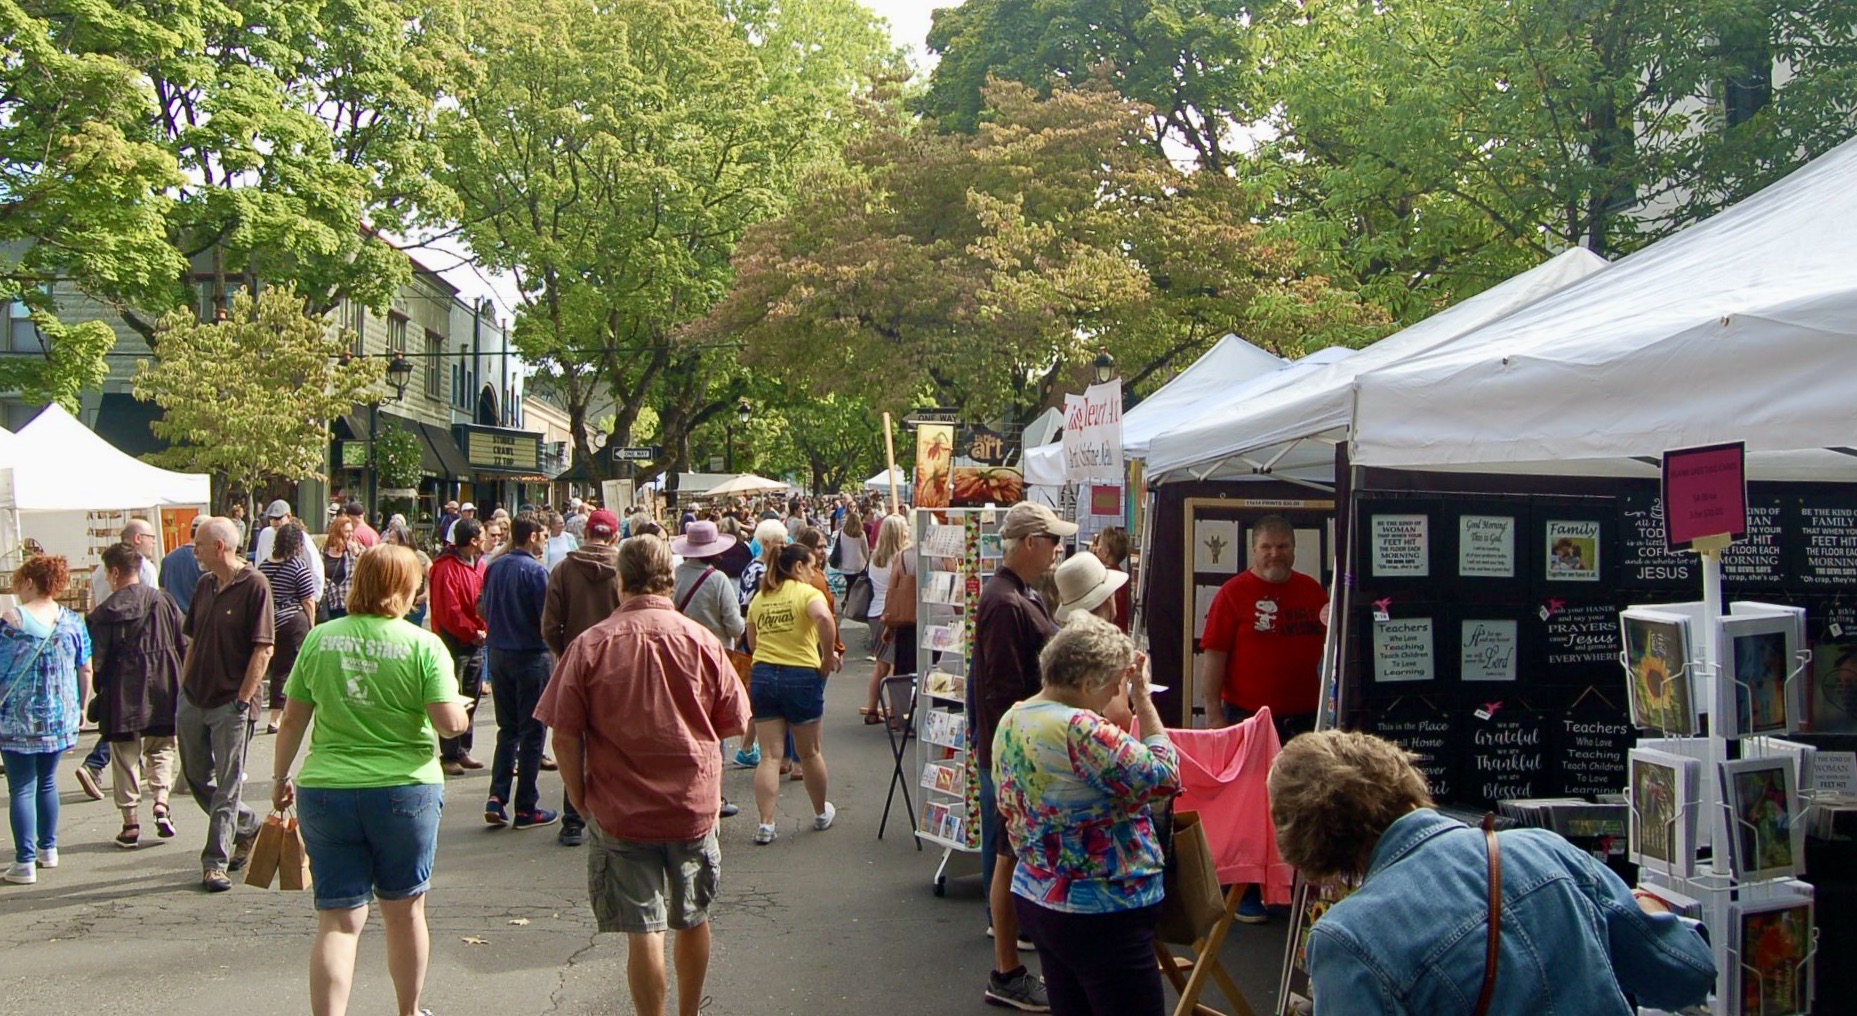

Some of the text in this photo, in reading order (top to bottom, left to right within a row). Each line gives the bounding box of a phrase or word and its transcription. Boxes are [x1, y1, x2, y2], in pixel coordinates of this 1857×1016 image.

[971, 438, 1004, 460] art
[1812, 517, 1854, 526] FAMILY
[1550, 522, 1597, 538] Family
[1638, 528, 1665, 538] TOD
[1753, 535, 1772, 545] HIT
[1812, 536, 1837, 546] FEET
[1821, 548, 1844, 556] FLOOR
[1637, 567, 1688, 579] JESUS
[757, 612, 794, 630] Camas
[1378, 623, 1428, 632] Teachers
[1548, 622, 1617, 633] PRAYERS
[1564, 634, 1617, 647] Jesus
[319, 636, 410, 660] EVENT STAFF
[1549, 652, 1620, 663] EVERYWHERE
[1418, 720, 1449, 732] Place
[1563, 720, 1627, 734] Teachers
[1412, 736, 1444, 748] Home
[1475, 728, 1540, 746] Grateful
[1576, 737, 1612, 747] Who Love
[1567, 749, 1620, 761] Teaching
[1475, 754, 1542, 771] Thankful
[1562, 761, 1624, 771] Teach Children
[1576, 774, 1608, 783] To Love
[1483, 781, 1532, 800] Blessed
[1565, 785, 1617, 794] Learning
